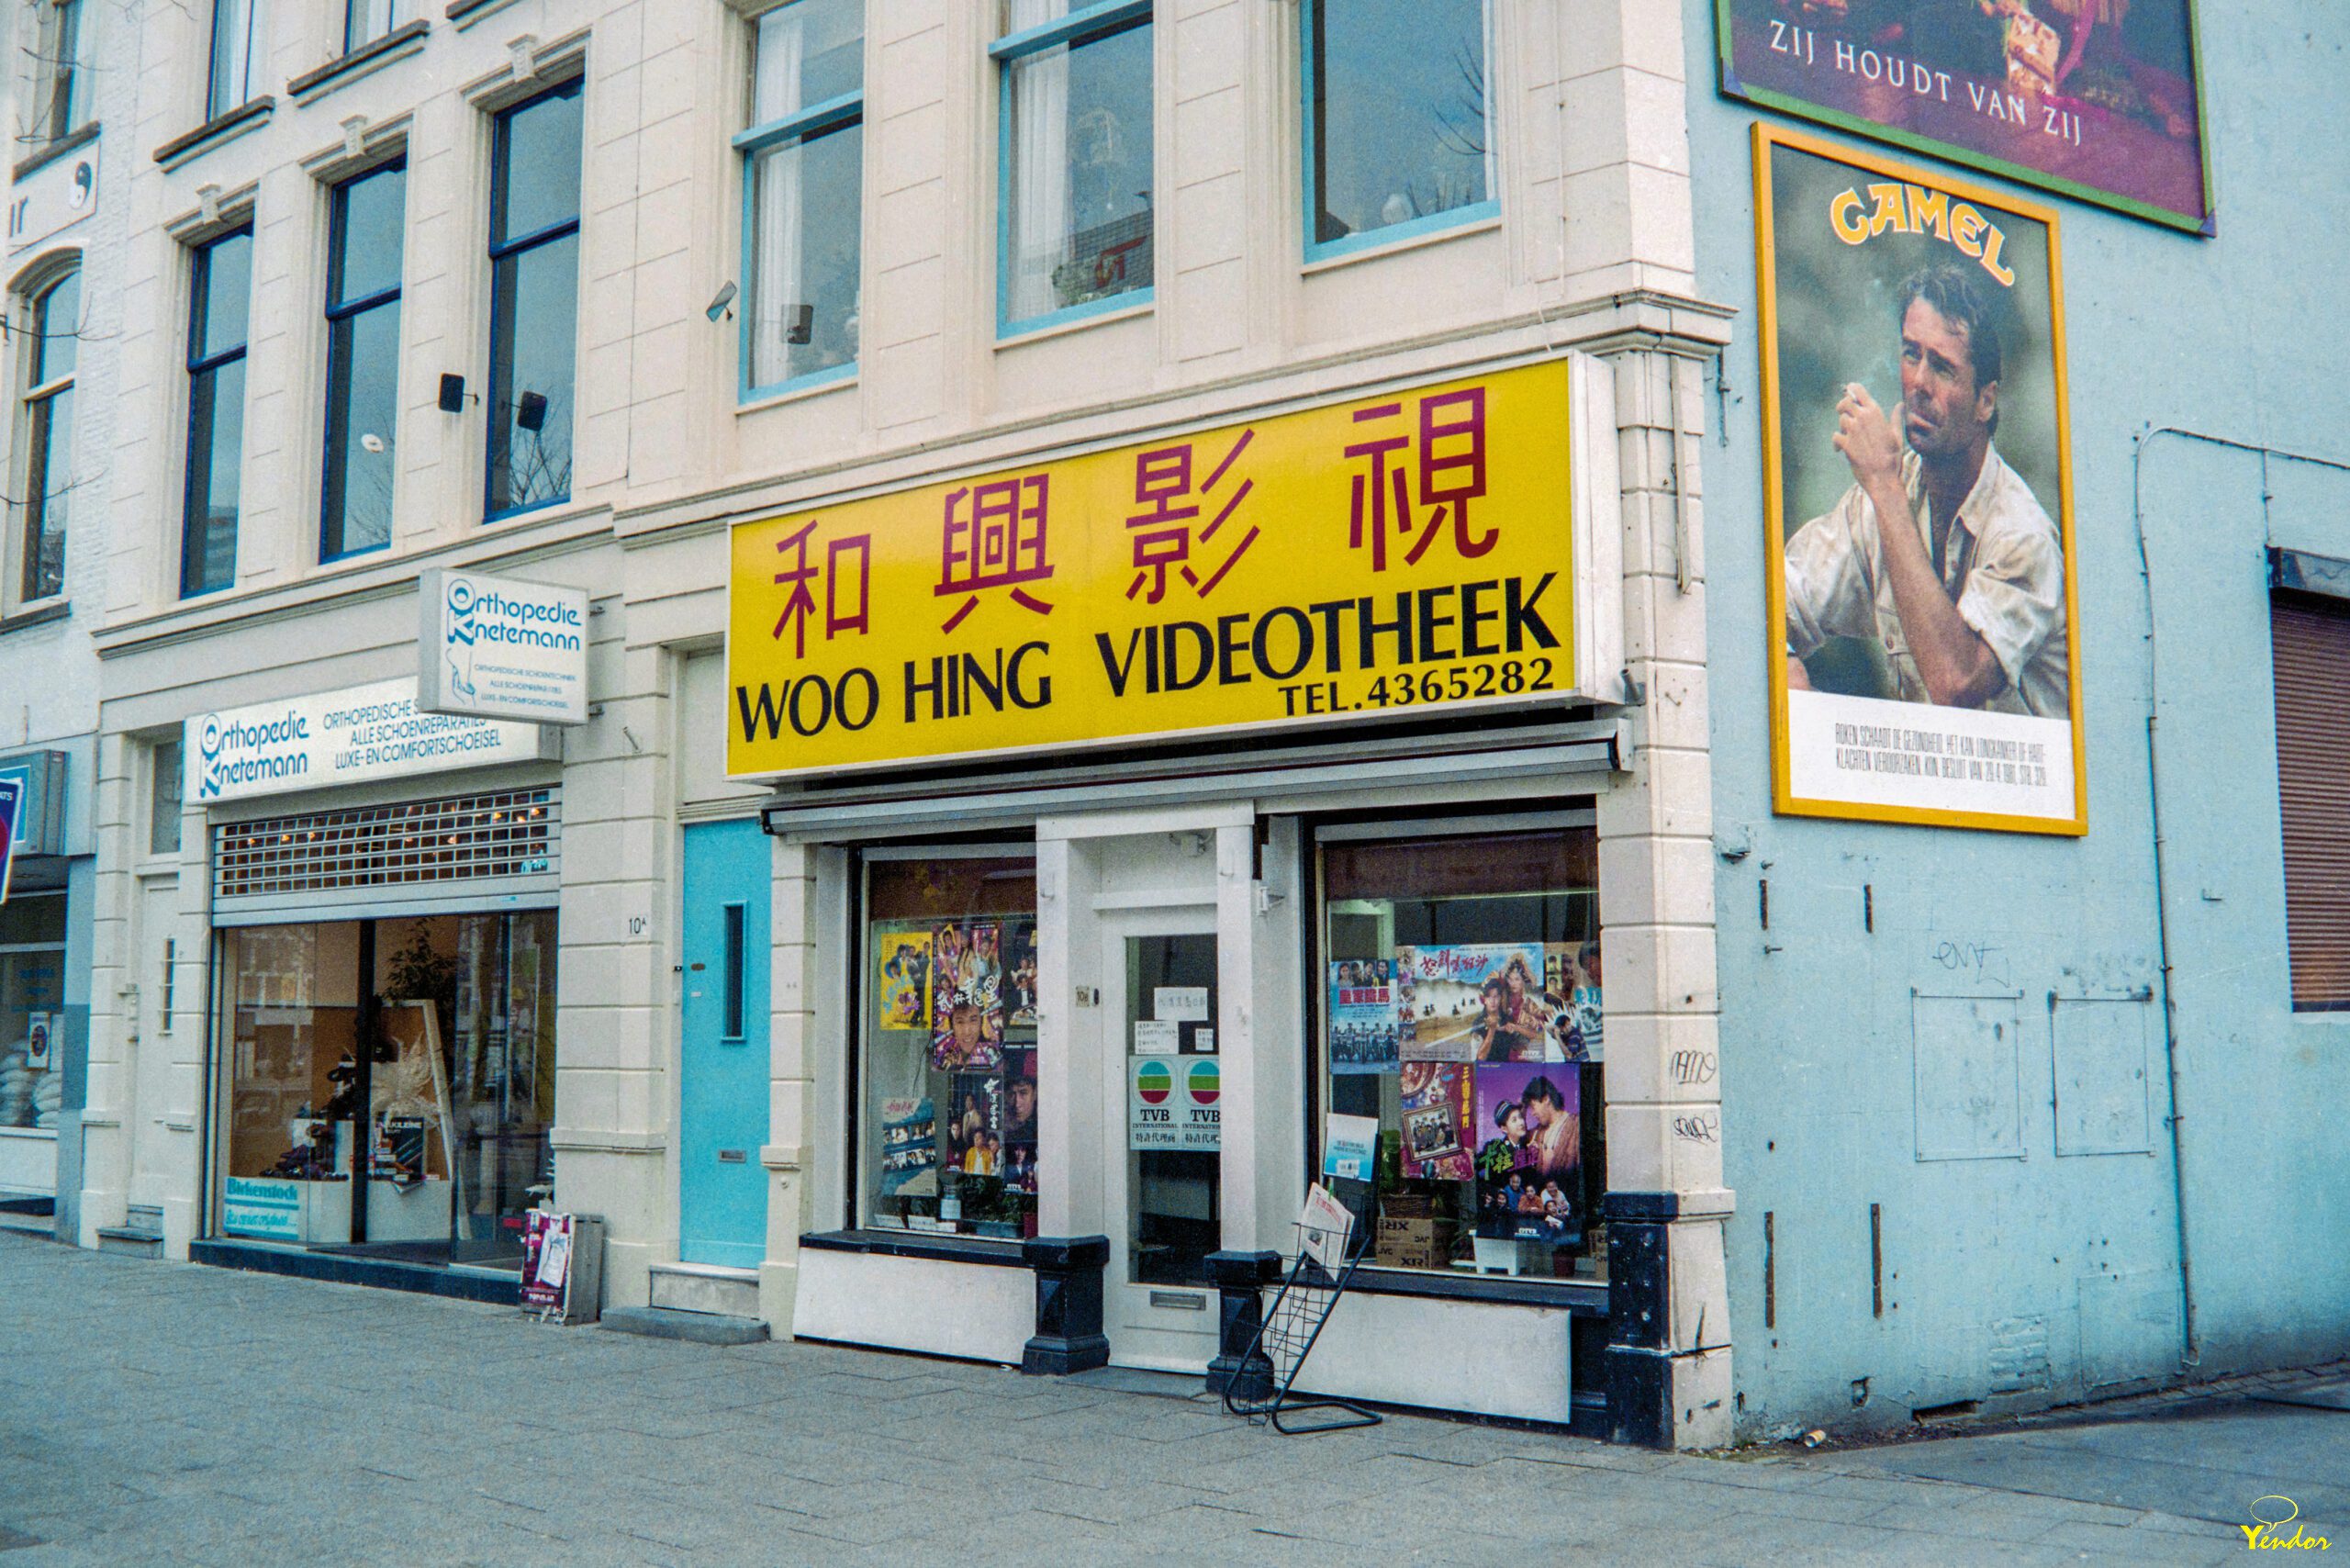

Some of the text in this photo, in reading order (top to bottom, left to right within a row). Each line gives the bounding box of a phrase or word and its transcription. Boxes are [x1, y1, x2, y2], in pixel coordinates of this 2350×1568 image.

[1770, 20, 2080, 146] ZIJ HOUDT VAN ZIJ
[1830, 183, 2016, 286] CAMEL
[773, 386, 1500, 659] 和興影視
[447, 578, 582, 626] Orthopedie
[446, 608, 581, 651] Knetemann
[736, 571, 1561, 744] WOO HING VIDEOTHEEK
[199, 710, 310, 760] Orthopedie
[323, 700, 411, 730] ORTHOPEDISCHE
[350, 726, 375, 746] ALLE
[335, 729, 501, 769] LUXE- EN COMFORTSCHOEISEL
[1836, 722, 1858, 745] ROKEN
[1860, 725, 1891, 748] SCHAADT
[1893, 728, 1901, 749] DE
[1946, 734, 1958, 755] HET
[1960, 735, 1974, 756] KAN
[199, 753, 308, 799] Knetemann
[1836, 747, 1871, 771] KLACHTEN
[1969, 760, 1983, 780] VAN
[1140, 1108, 1169, 1122] TVB
[1190, 1109, 1220, 1123] TVB
